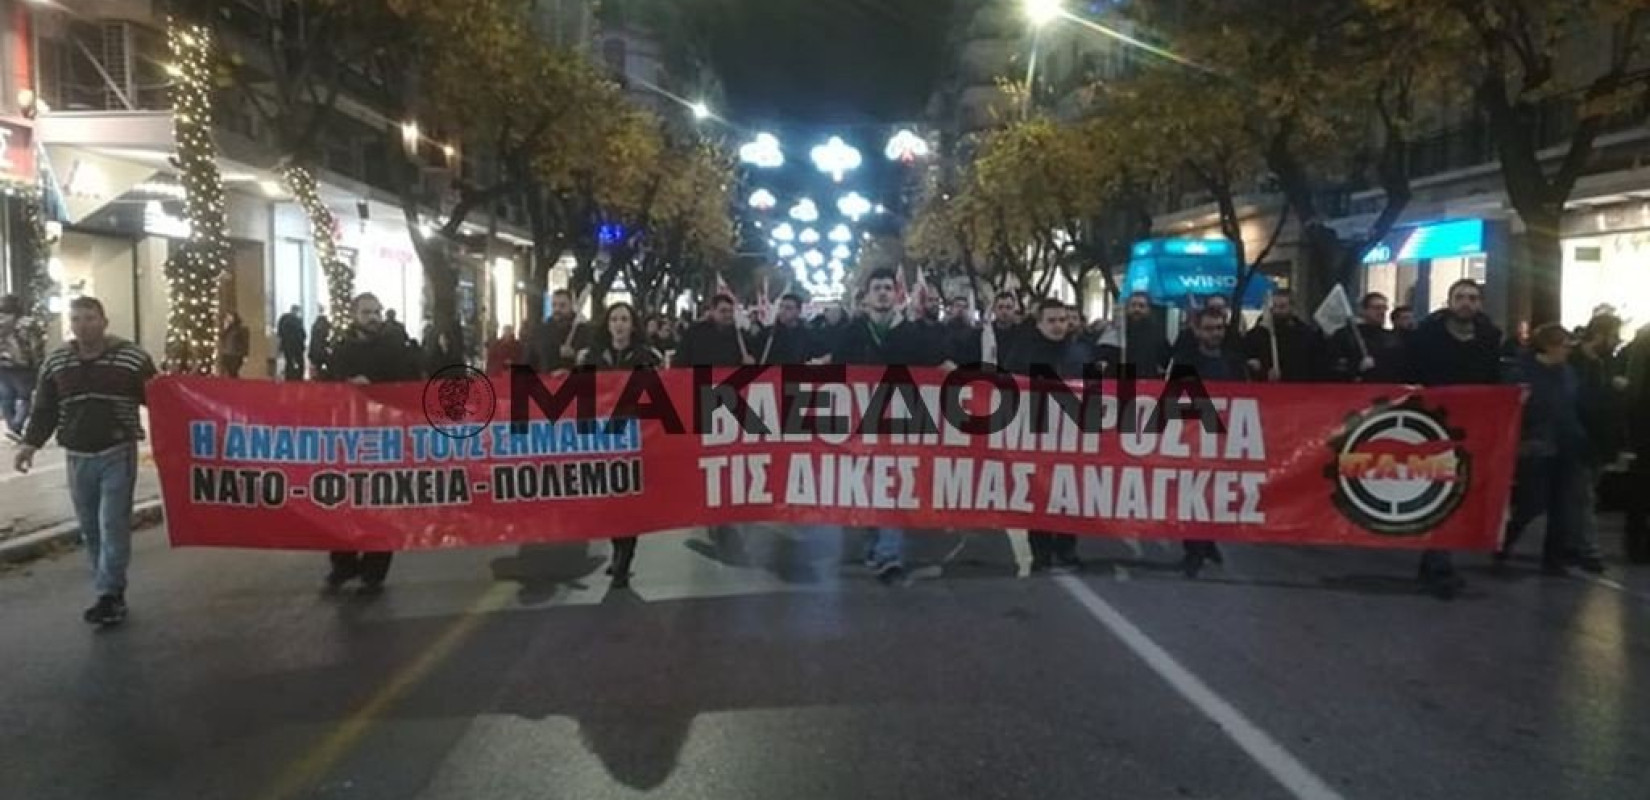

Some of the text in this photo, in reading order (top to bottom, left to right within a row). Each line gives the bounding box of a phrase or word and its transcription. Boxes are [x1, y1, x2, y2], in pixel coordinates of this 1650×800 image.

[1179, 275, 1237, 288] WIND
[190, 417, 642, 463] Η ΑΝΑΠΤΥΞΗ ΤΟΥΣ ΣΗΜΑΙΝΕΙ
[701, 381, 1265, 461] ΒΑΖΟΥΜΕ ΜΠΡΟΣΤΑ
[192, 466, 285, 506] ΝΑΤΟ
[312, 466, 469, 508] ΦΤΩΧΕΙΑ
[491, 459, 642, 501] ΠΟΛΕΜΟΙ
[699, 453, 1267, 523] ΤΙΣ ΔΙΚΕΣ ΜΑΣ ΑΝΑΓΚΕΣ
